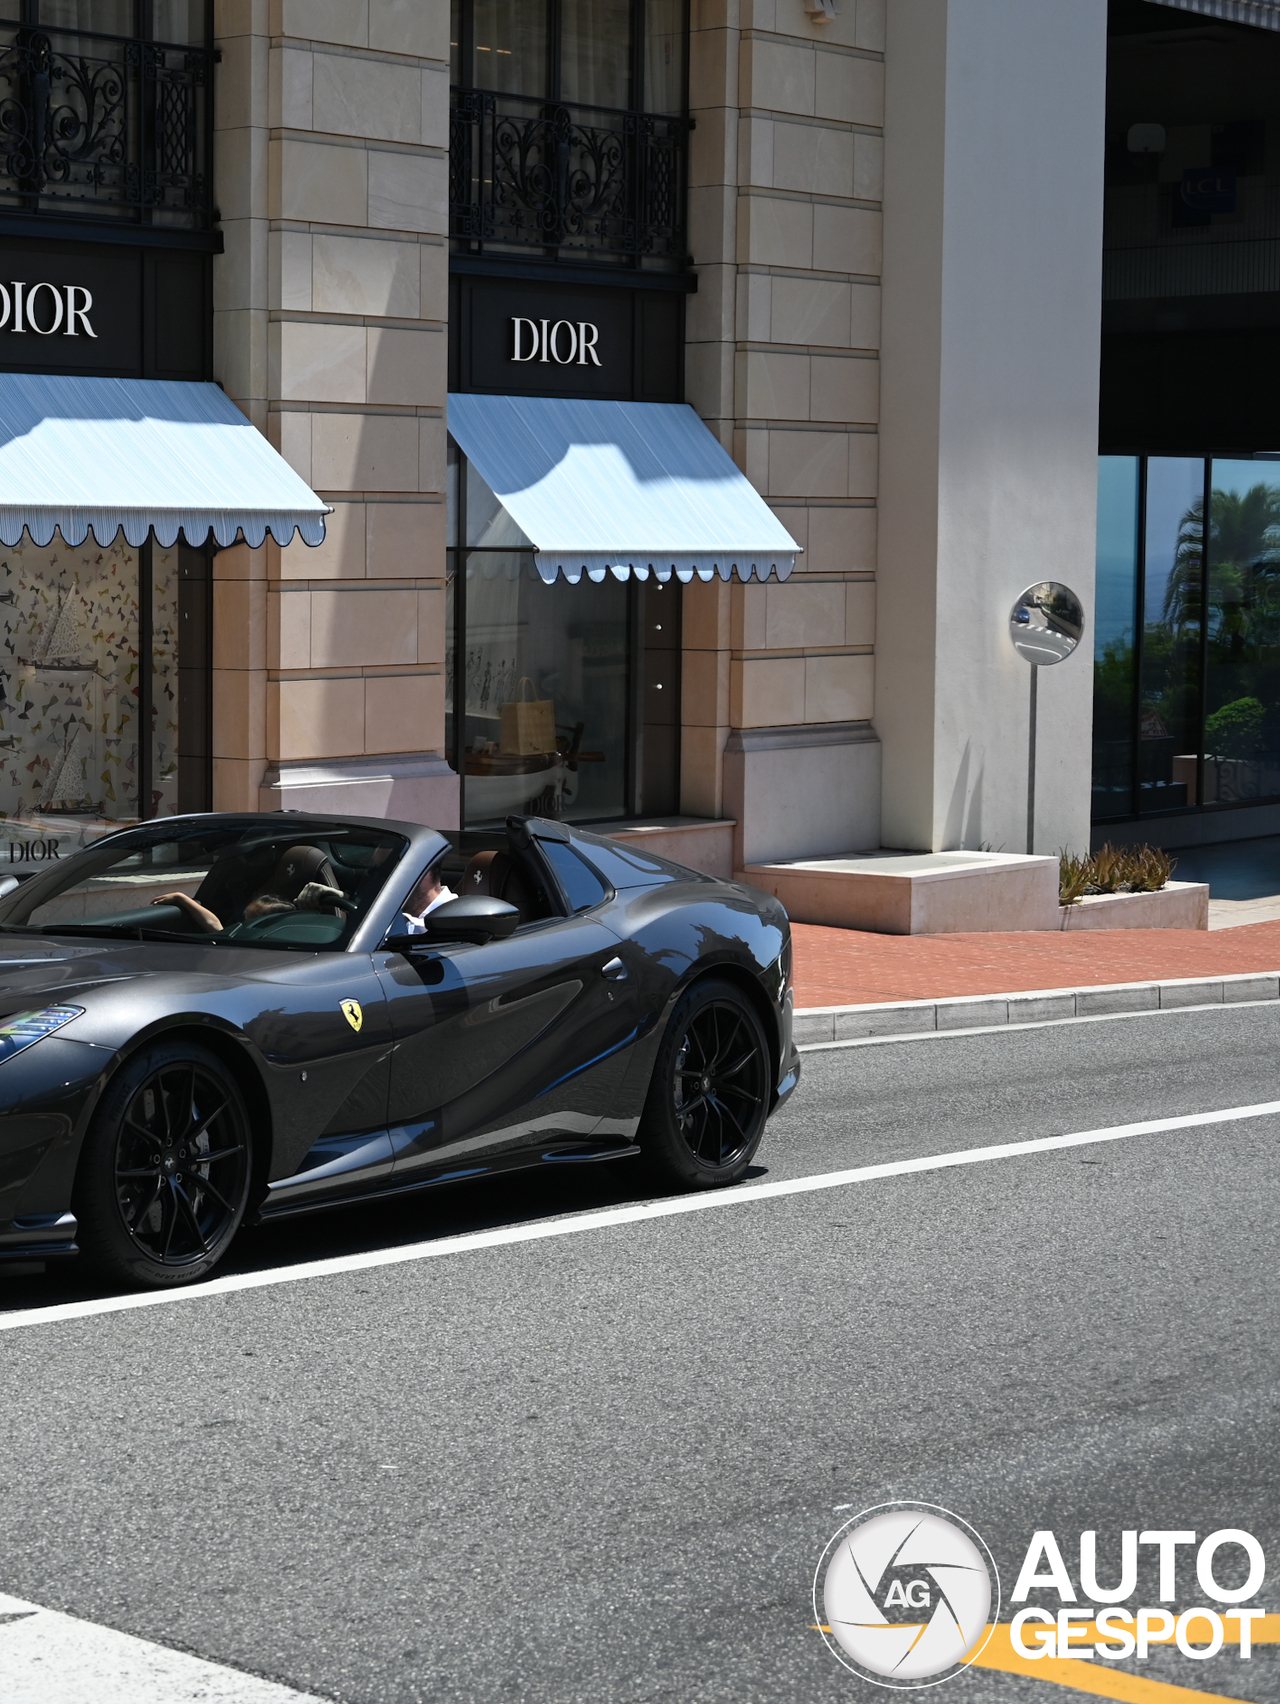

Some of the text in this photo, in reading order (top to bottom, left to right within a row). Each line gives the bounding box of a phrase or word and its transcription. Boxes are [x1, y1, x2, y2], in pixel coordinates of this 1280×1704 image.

[1186, 178, 1228, 194] LCL
[511, 317, 602, 366] DIOR
[530, 795, 567, 815] DIOR
[10, 838, 61, 864] DIOR
